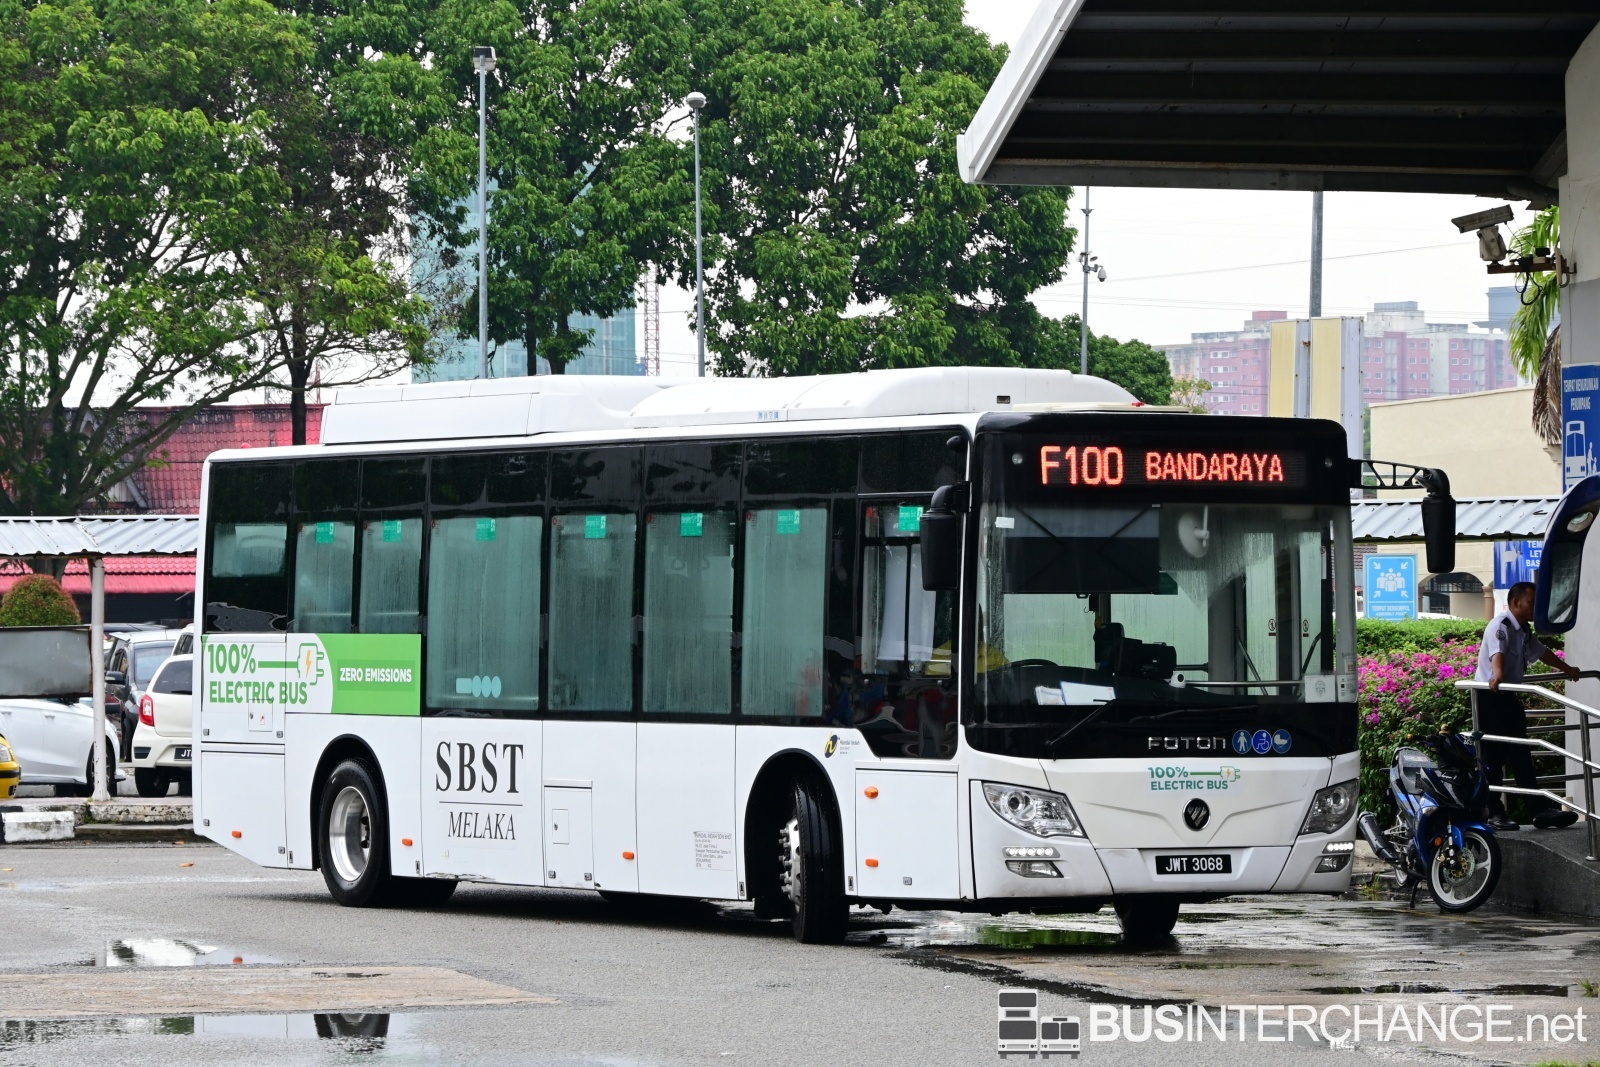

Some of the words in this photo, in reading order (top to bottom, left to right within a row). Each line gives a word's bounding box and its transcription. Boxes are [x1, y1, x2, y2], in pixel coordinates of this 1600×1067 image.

[1570, 396, 1591, 411] PENUMPANG
[1040, 445, 1123, 485] F100
[1146, 452, 1284, 481] BANDARAYA
[207, 643, 256, 674] 100%
[339, 667, 363, 682] ZERO
[365, 668, 412, 682] EMISSIONS
[209, 681, 275, 704] ELECTRIC
[279, 681, 308, 704] BUS
[1147, 736, 1226, 750] FOTON
[435, 741, 524, 794] SBST
[1147, 766, 1188, 779] 100%
[1151, 781, 1204, 790] ELECTRIC
[1207, 780, 1229, 790] BUS
[448, 811, 516, 841] MELAKA
[1165, 858, 1188, 872] JWT
[1192, 857, 1223, 871] 3068
